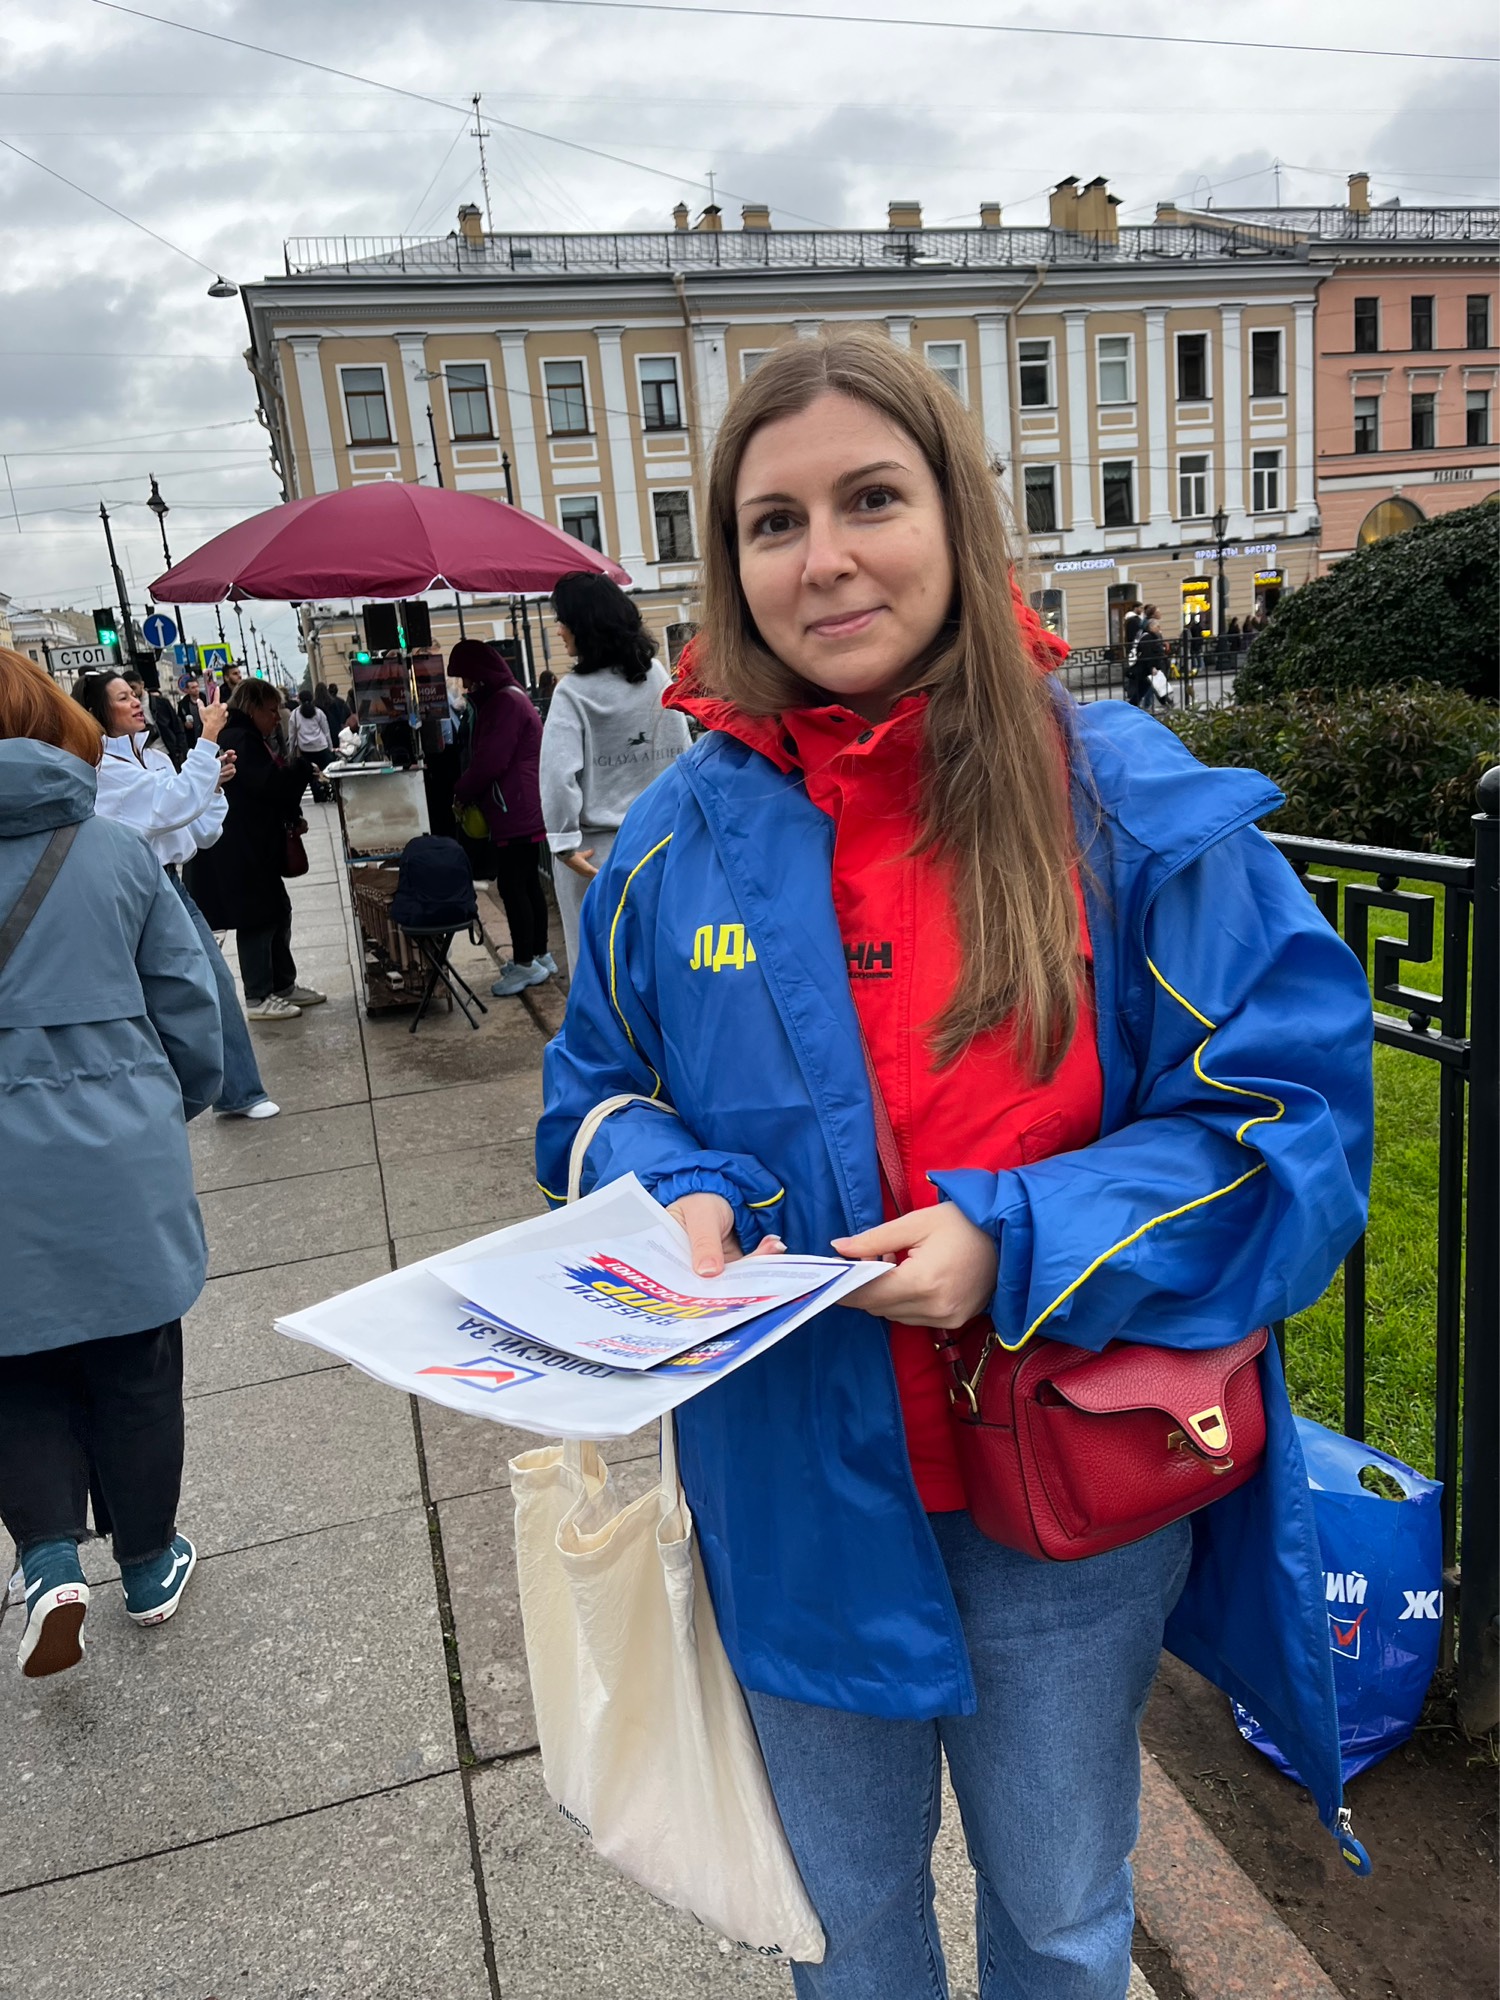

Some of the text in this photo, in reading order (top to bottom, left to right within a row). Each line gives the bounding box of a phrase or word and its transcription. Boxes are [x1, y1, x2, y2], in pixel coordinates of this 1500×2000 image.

[1195, 547, 1238, 560] ПРОДКТЫ
[61, 649, 105, 665] СТОП
[591, 1279, 728, 1320] ЛДПР
[606, 1261, 691, 1304] РОССИЮ!
[564, 1281, 682, 1327] ВЫБЕРИ
[457, 1318, 497, 1340] ЗА
[487, 1337, 616, 1379] ГОЛОСУЙ
[1322, 1570, 1368, 1604] ИЙ
